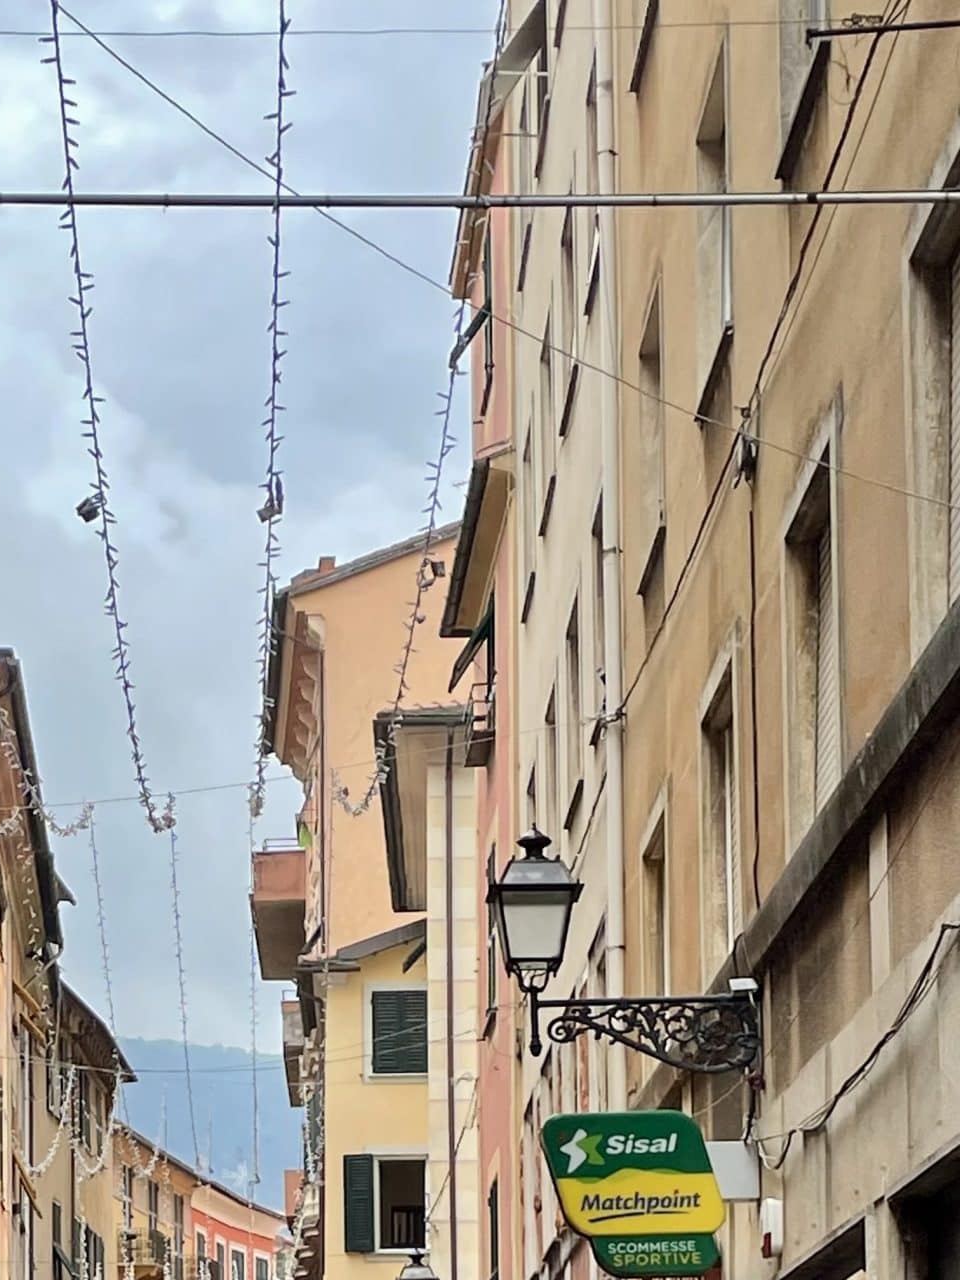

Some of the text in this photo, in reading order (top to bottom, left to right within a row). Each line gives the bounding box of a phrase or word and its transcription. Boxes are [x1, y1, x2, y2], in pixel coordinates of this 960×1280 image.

[606, 1132, 678, 1155] Sisal
[580, 1189, 702, 1214] Matchpoint
[607, 1240, 697, 1254] SCOMMESSE
[613, 1252, 702, 1267] SPORTIVE
